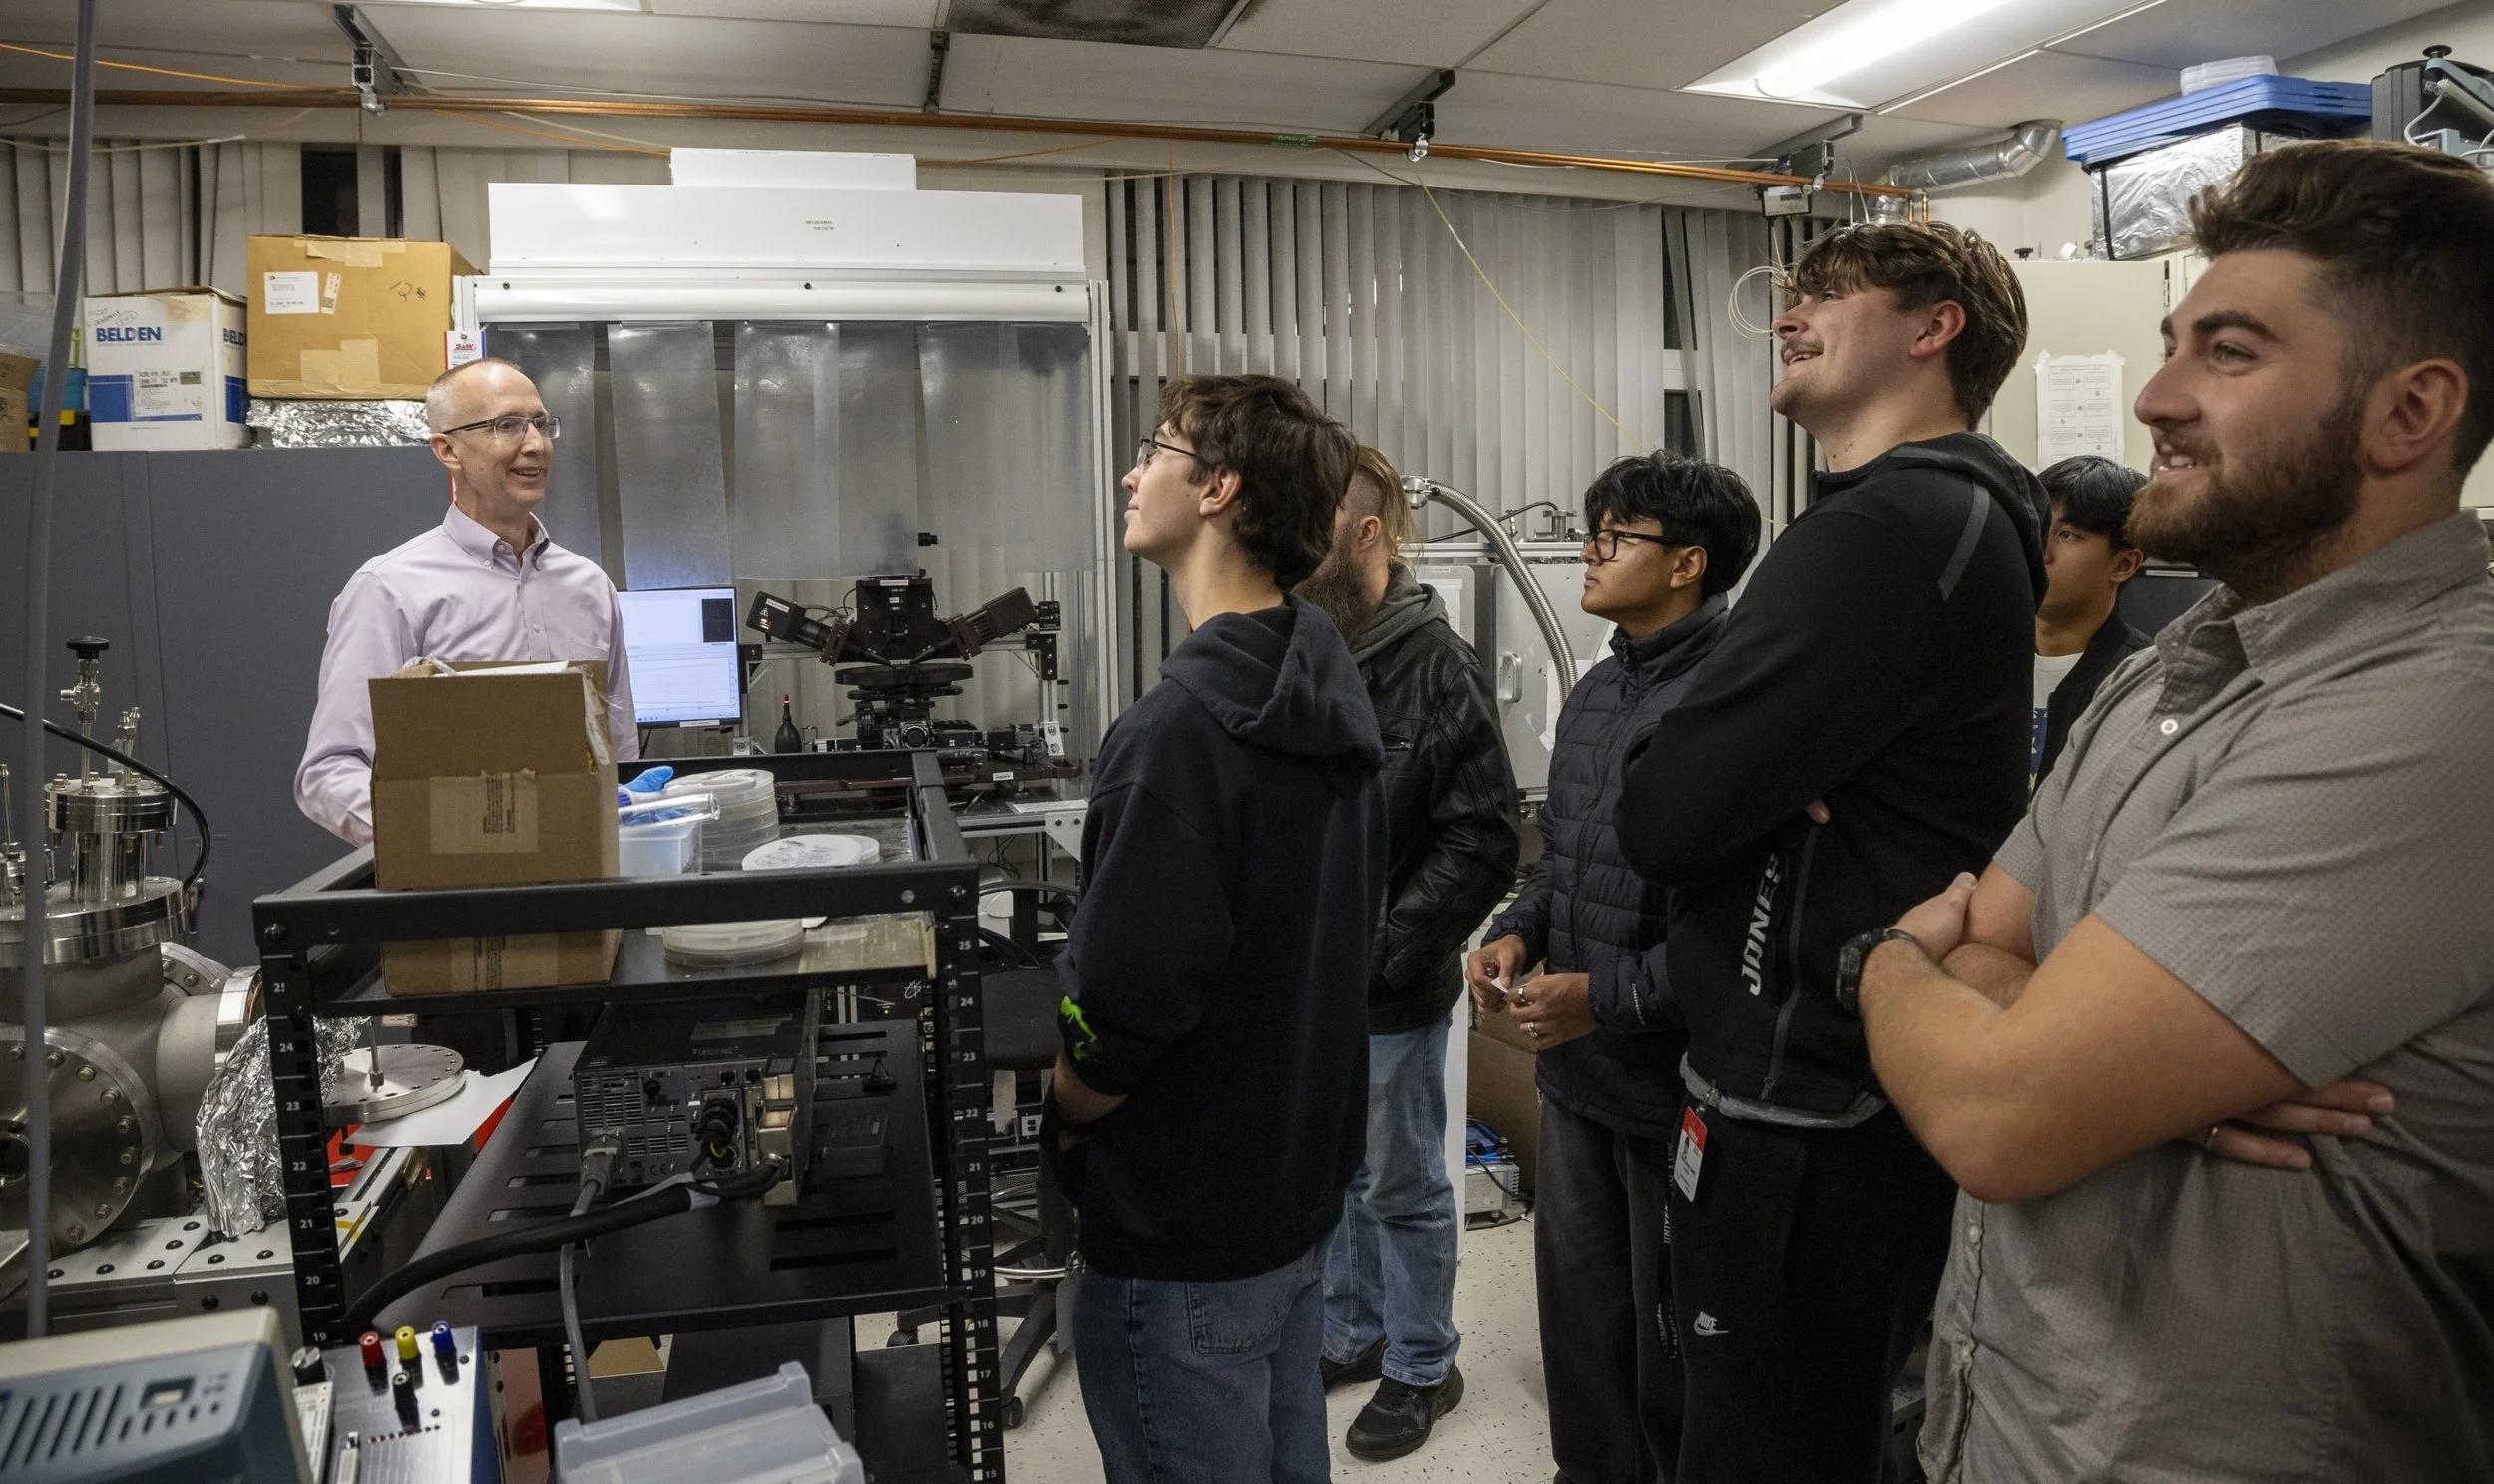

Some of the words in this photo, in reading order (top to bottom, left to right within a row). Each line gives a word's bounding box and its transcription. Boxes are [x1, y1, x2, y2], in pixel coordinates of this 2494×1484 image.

[96, 327, 162, 342] BELDEN
[958, 940, 972, 951] 25
[959, 996, 974, 1007] 24
[279, 1042, 294, 1053] 24
[962, 1052, 976, 1062] 23
[285, 1101, 300, 1112] 23
[965, 1108, 978, 1118] 22
[292, 1161, 307, 1172] 22
[968, 1162, 981, 1172] 21
[299, 1219, 313, 1229] 21
[970, 1215, 984, 1225] 20
[973, 1268, 987, 1278] 19
[305, 1275, 320, 1286] 20
[976, 1318, 989, 1329] 18
[1698, 1310, 1718, 1331] NIKE
[312, 1332, 327, 1342] 19
[979, 1369, 992, 1379] 17
[981, 1420, 995, 1430] 16
[984, 1469, 998, 1479] 15
